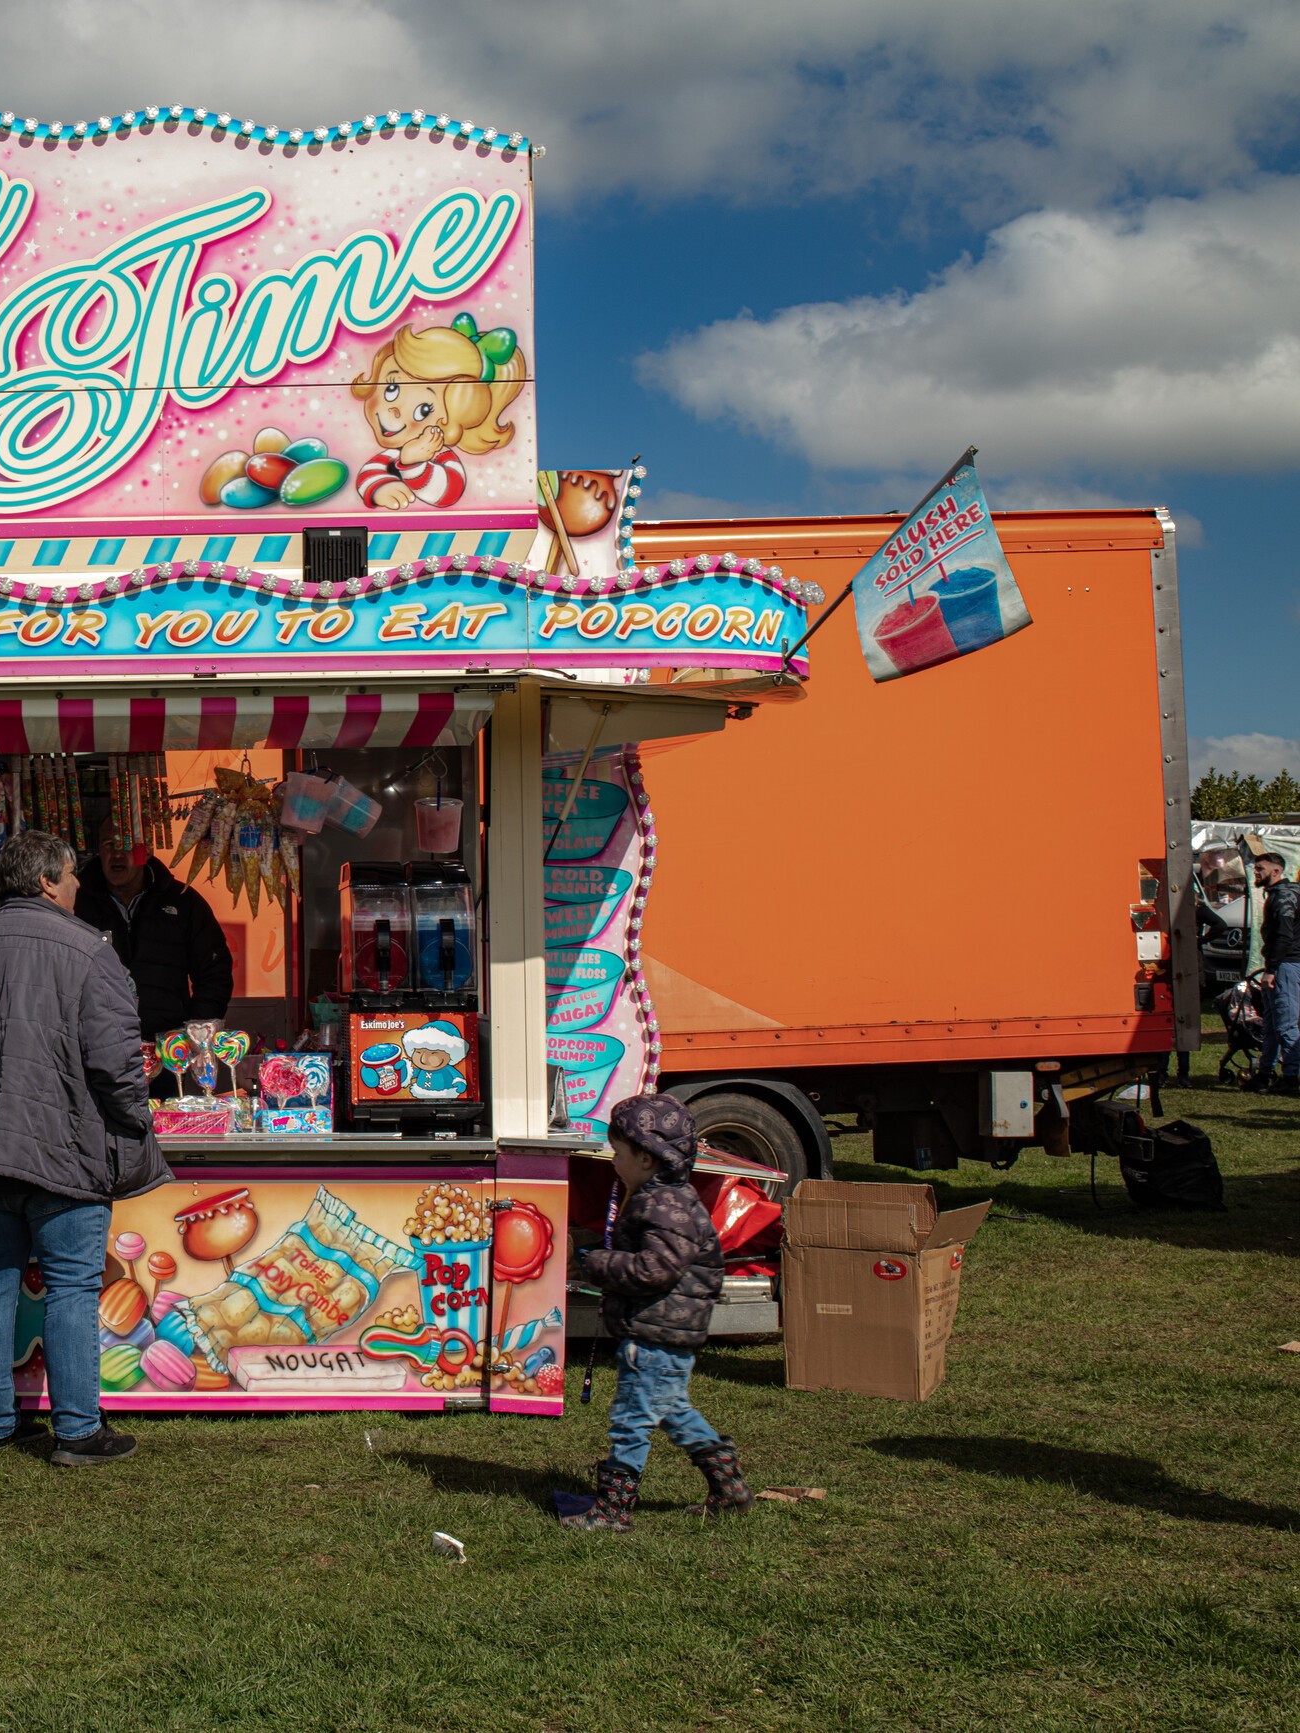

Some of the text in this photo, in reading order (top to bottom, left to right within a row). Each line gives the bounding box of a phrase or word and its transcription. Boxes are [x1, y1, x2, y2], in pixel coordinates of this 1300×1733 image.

[883, 495, 957, 562] SLUSH
[874, 502, 985, 590] SOLD HERE
[134, 608, 259, 650] YOU
[275, 604, 354, 646] TO
[378, 601, 507, 641] EAT
[538, 602, 784, 646] POPCORN
[542, 782, 601, 799] OFFEE
[550, 869, 603, 881] COLD
[545, 902, 611, 924] WEETS
[562, 952, 601, 964] LOLLIES
[545, 968, 607, 979] ANDY FLOSS
[547, 990, 597, 1009] ONUT ICE
[546, 1001, 605, 1027] OUGAT
[360, 1020, 387, 1029] Eskimo
[546, 1037, 607, 1052] OPCORN
[546, 1050, 595, 1062] FLUMPS
[421, 1253, 471, 1290] Pop
[296, 1282, 349, 1326] Combe
[265, 1352, 365, 1372] NOUGAT
